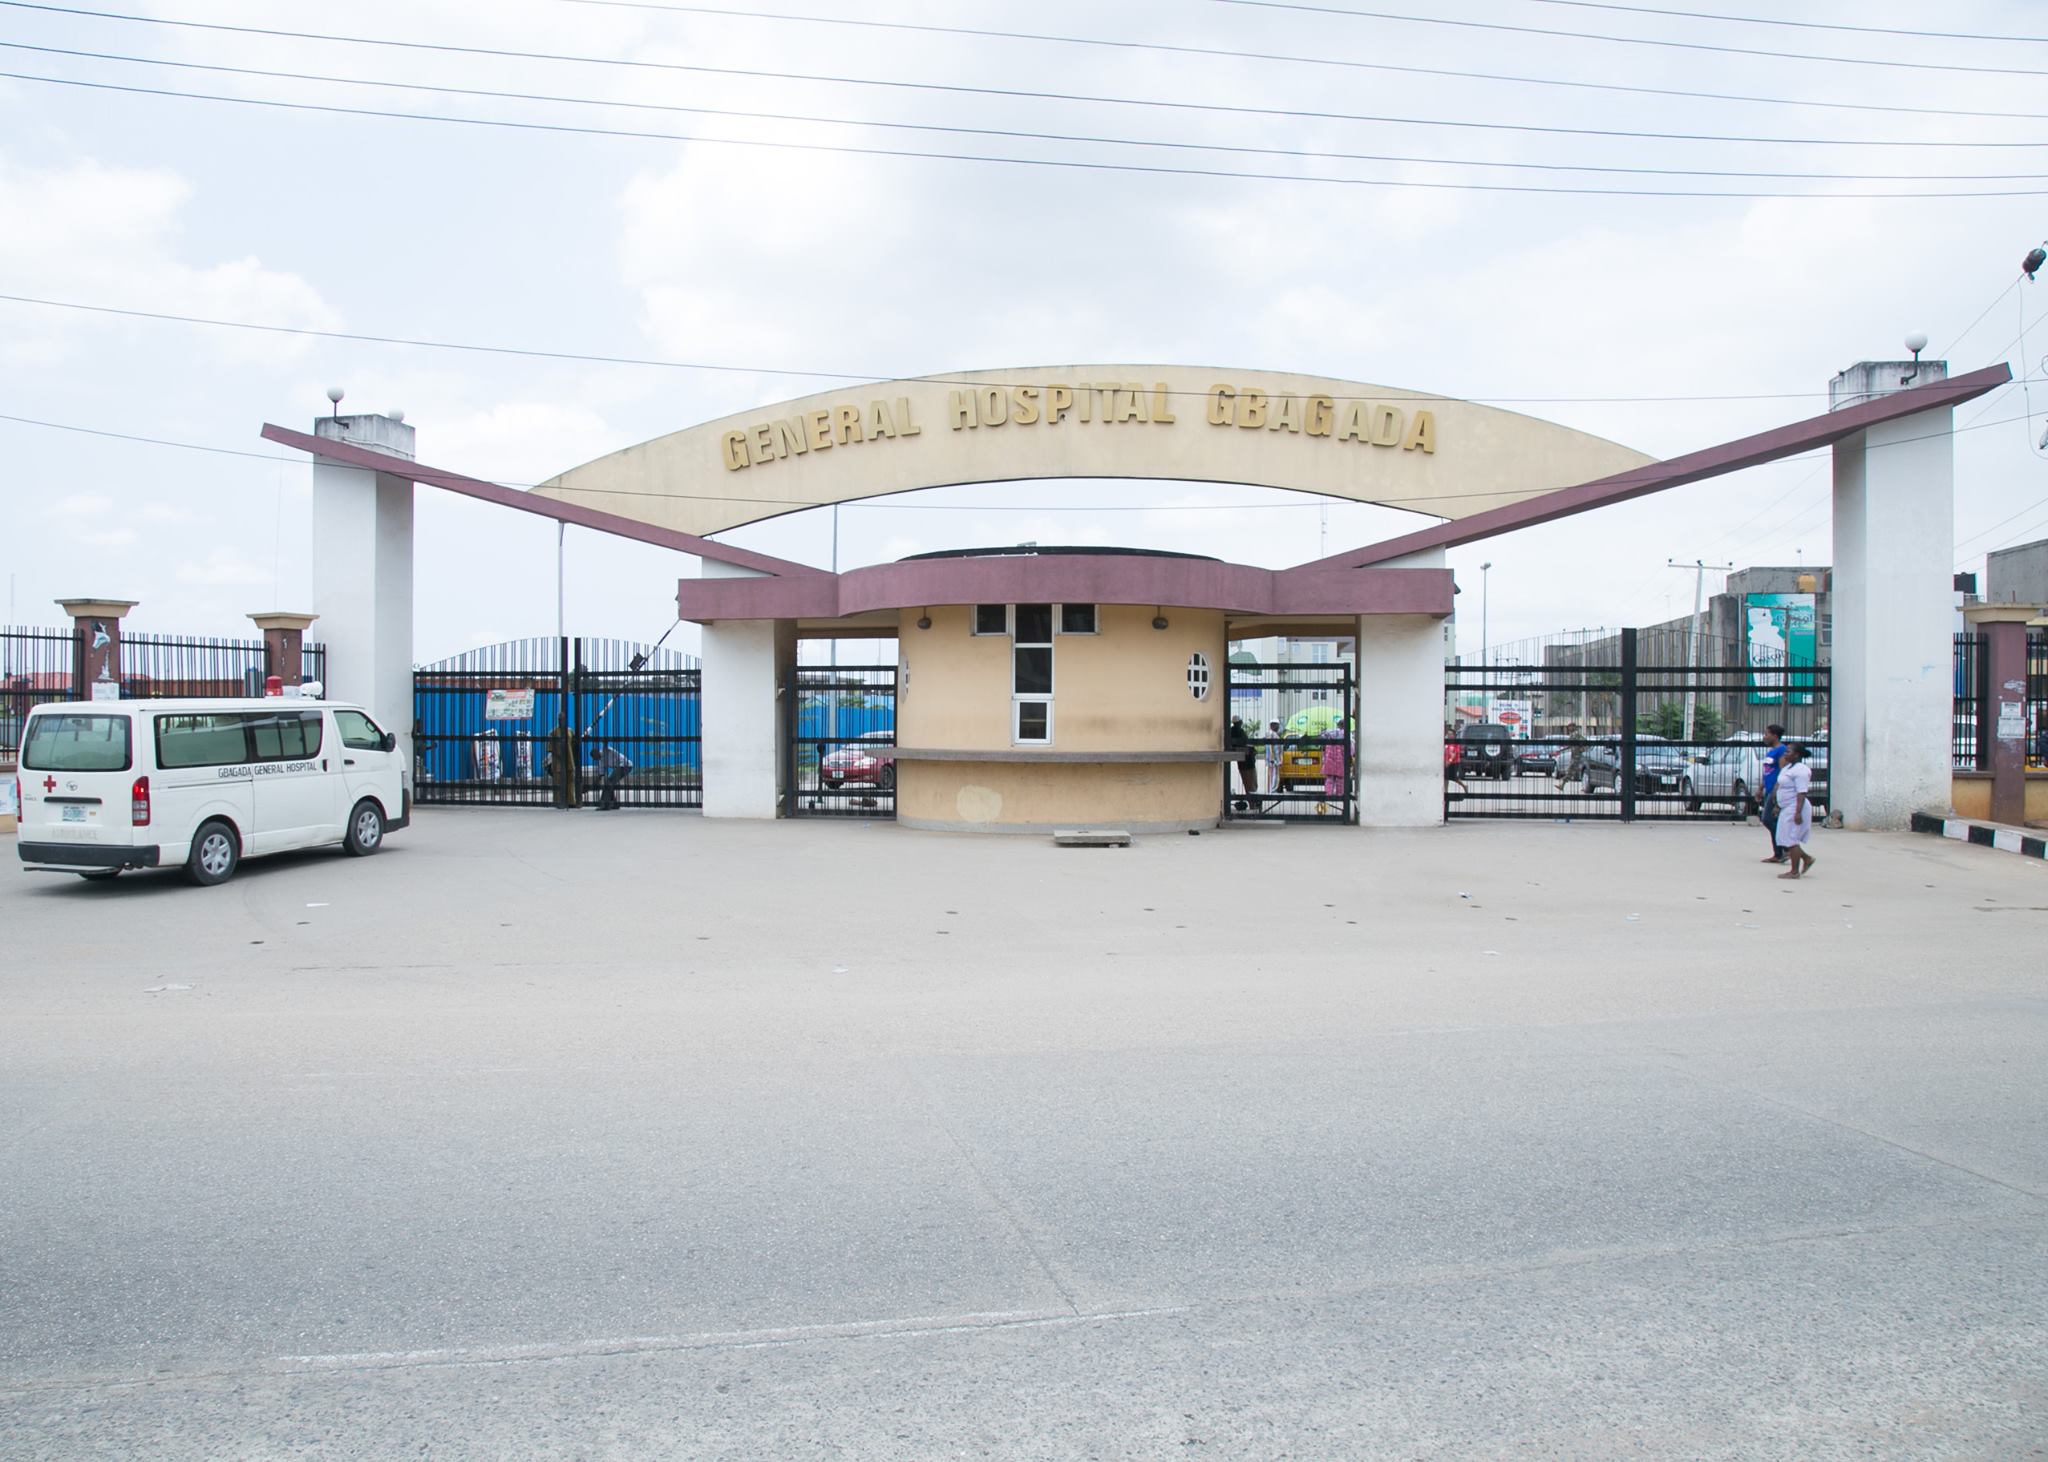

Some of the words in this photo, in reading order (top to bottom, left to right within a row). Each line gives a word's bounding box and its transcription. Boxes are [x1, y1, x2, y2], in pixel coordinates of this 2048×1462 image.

[721, 397, 921, 471] GENERAL
[952, 382, 1176, 431] HOSPITAL
[1207, 383, 1435, 454] GBAGADA
[218, 766, 252, 778] GBAGADA
[254, 764, 284, 776] GENERAL
[286, 762, 317, 772] HOSPITAL
